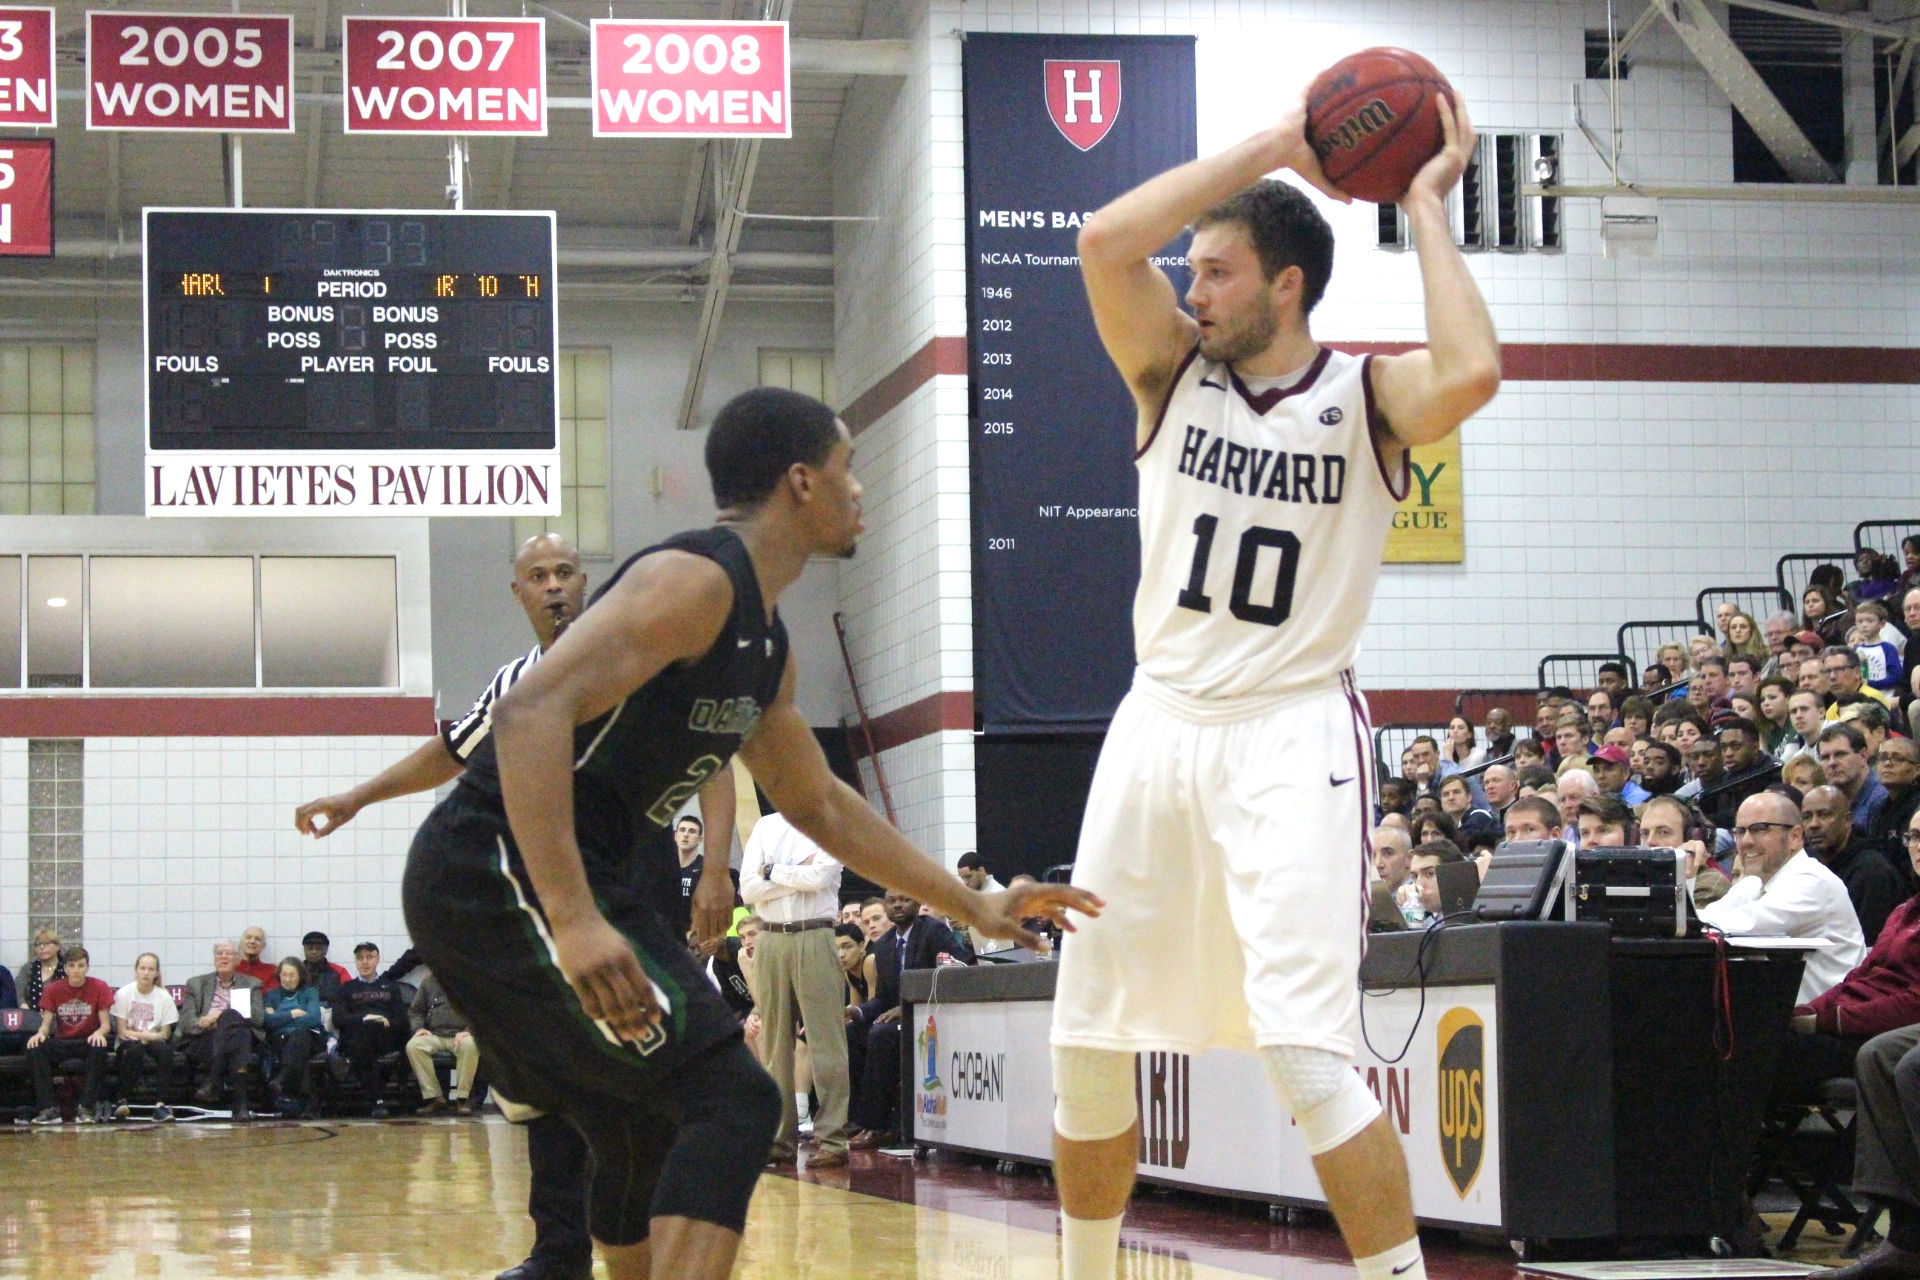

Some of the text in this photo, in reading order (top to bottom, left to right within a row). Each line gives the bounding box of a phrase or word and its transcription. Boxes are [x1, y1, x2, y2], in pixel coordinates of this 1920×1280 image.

[119, 25, 263, 68] 2005
[376, 30, 515, 71] 2007
[622, 33, 761, 75] 2008
[94, 82, 285, 119] WOMEN
[351, 86, 537, 121] WOMEN
[1063, 69, 1102, 123] H
[599, 88, 782, 124] WOMEN
[979, 210, 1046, 228] MEN'S
[981, 252, 1022, 265] NCAA
[323, 269, 380, 278] DAKTRONICS
[317, 281, 388, 298] PERIOD
[981, 287, 1013, 300] 1946
[267, 306, 335, 323] BONUS
[372, 306, 439, 323] BONUS
[982, 319, 1013, 332] 2012
[267, 332, 321, 349] POSS
[384, 333, 438, 349] POSS
[155, 356, 219, 373] FOULS
[301, 356, 438, 373] PLAYER FOUL
[488, 356, 550, 373] FOULS
[982, 353, 1013, 366] 2013
[983, 388, 1014, 401] 2014
[984, 422, 1015, 435] 2015
[1178, 424, 1346, 505] HARVARD
[151, 465, 552, 507] LAVIETES PAVILION
[1039, 505, 1063, 518] NIT
[988, 538, 1016, 551] 2011
[1177, 513, 1302, 628] 10
[951, 1051, 1004, 1102] CHOBANI
